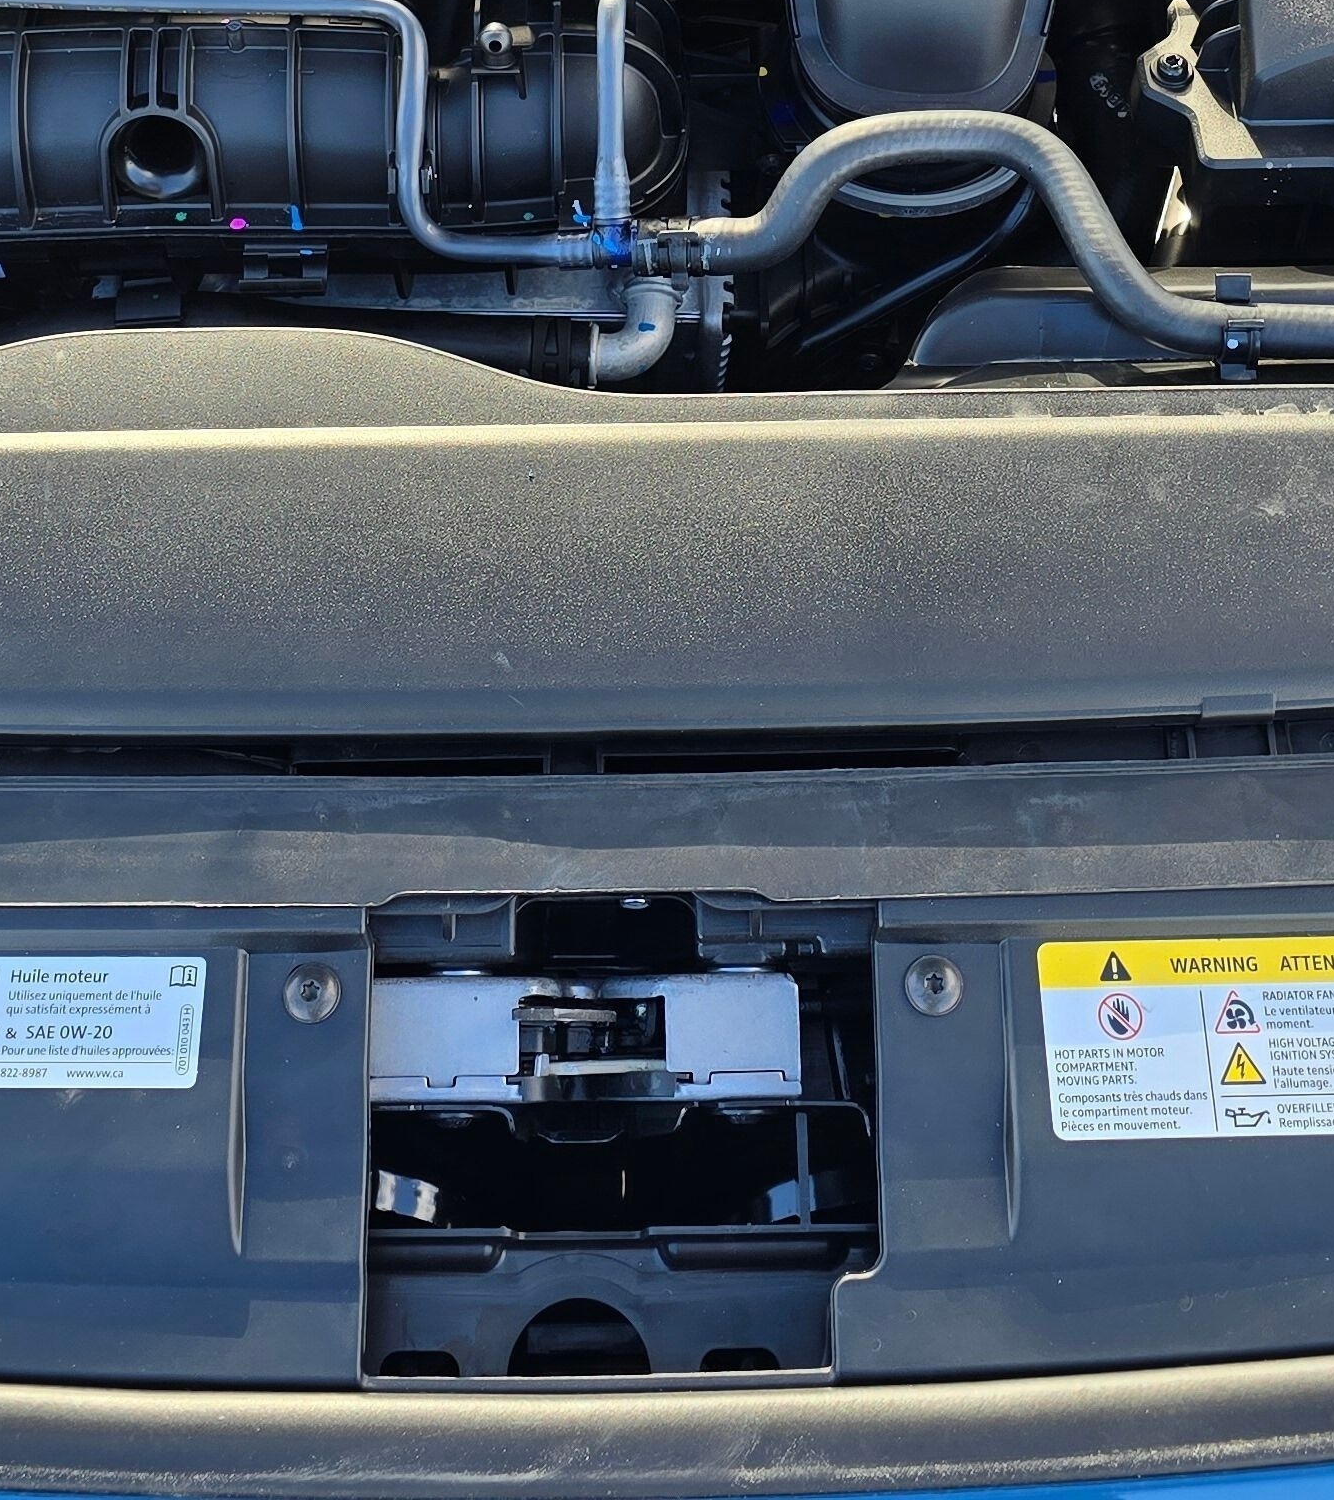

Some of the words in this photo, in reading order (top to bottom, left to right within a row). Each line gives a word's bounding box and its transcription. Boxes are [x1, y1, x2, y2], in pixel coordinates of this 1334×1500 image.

[1169, 956, 1258, 974] WARNING
[10, 969, 50, 983] Huile
[53, 969, 109, 984] moteur
[8, 989, 47, 1001] Utilisez
[48, 990, 113, 1004] uniquement
[115, 989, 129, 1001] de
[130, 989, 163, 1001] l'huile
[1262, 990, 1315, 1001] RADIATOR
[5, 1006, 23, 1017] qui
[25, 1003, 67, 1015] satisfait
[68, 1004, 142, 1018] expressément
[144, 1003, 151, 1015] à
[183, 1007, 191, 1015] H
[1264, 1005, 1277, 1017] Le
[181, 1017, 191, 1036] 043
[1266, 1019, 1314, 1030] moment.
[5, 1027, 17, 1040] &
[25, 1025, 56, 1040] SAE
[59, 1025, 113, 1040] 0W-20
[180, 1037, 189, 1054] 010
[1268, 1037, 1295, 1049] HIGH
[1, 1044, 26, 1056] Pour
[26, 1047, 47, 1056] une
[48, 1044, 70, 1056] liste
[71, 1044, 111, 1056] d'huiles
[111, 1044, 175, 1059] approuvées:
[1054, 1049, 1076, 1060] HOT
[1078, 1048, 1111, 1059] PARTS
[1112, 1048, 1124, 1059] IN
[1126, 1047, 1165, 1058] MOTOR
[1269, 1049, 1317, 1061] IGNITION
[178, 1056, 187, 1074] 701
[1055, 1061, 1138, 1073] COMPARTMENT.
[1272, 1065, 1305, 1077] Haute
[66, 1070, 124, 1078] www.vw.ca
[1056, 1075, 1100, 1087] MOVING
[1101, 1074, 1137, 1085] PARTS.
[1273, 1077, 1332, 1091] l'allumage.
[1058, 1092, 1122, 1105] Composants
[1123, 1090, 1144, 1102] très
[1145, 1090, 1182, 1102] chauds
[1183, 1089, 1208, 1101] dans
[1059, 1106, 1070, 1118] le
[1071, 1105, 1149, 1120] compartiment
[1150, 1105, 1193, 1116] moteur.
[1061, 1120, 1095, 1132] Pièces
[1097, 1122, 1111, 1131] en
[1113, 1120, 1181, 1131] mouvement.
